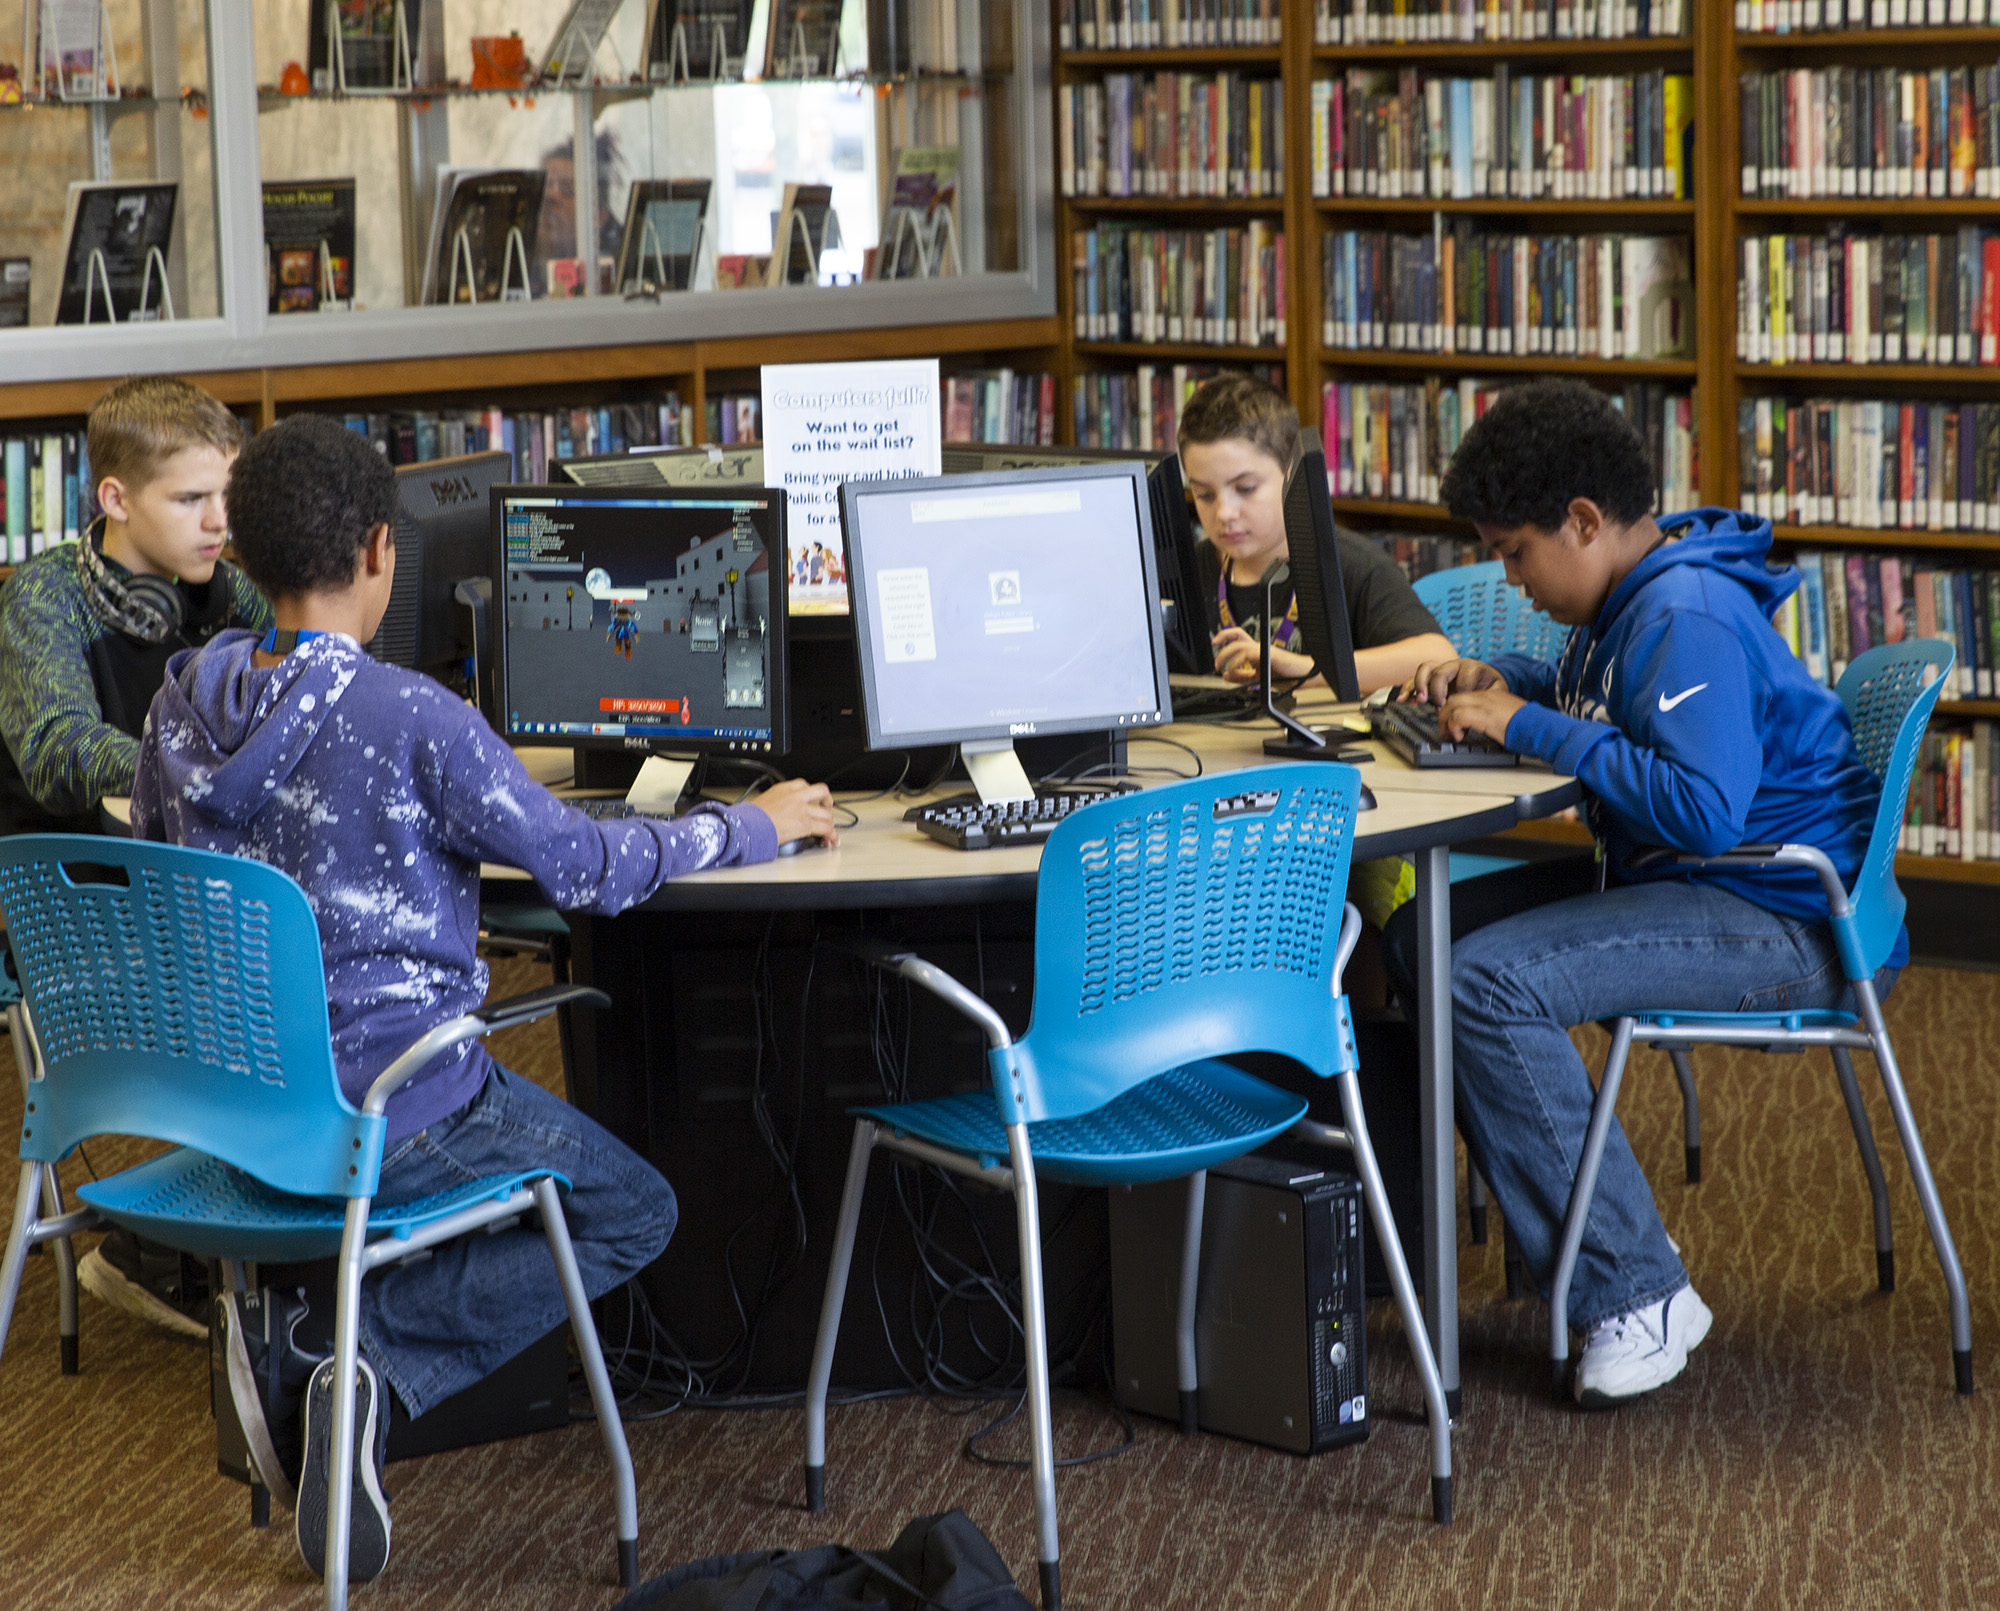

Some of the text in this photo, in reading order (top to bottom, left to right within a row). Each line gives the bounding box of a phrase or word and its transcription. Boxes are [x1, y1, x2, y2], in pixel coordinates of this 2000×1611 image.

[773, 385, 930, 412] Computers full?
[806, 418, 899, 436] Want to get
[791, 436, 914, 452] on the wait list?
[784, 467, 924, 486] Bring your card to the
[807, 512, 825, 525] for
[1009, 722, 1037, 736] DELL
[624, 737, 651, 750] DELL
